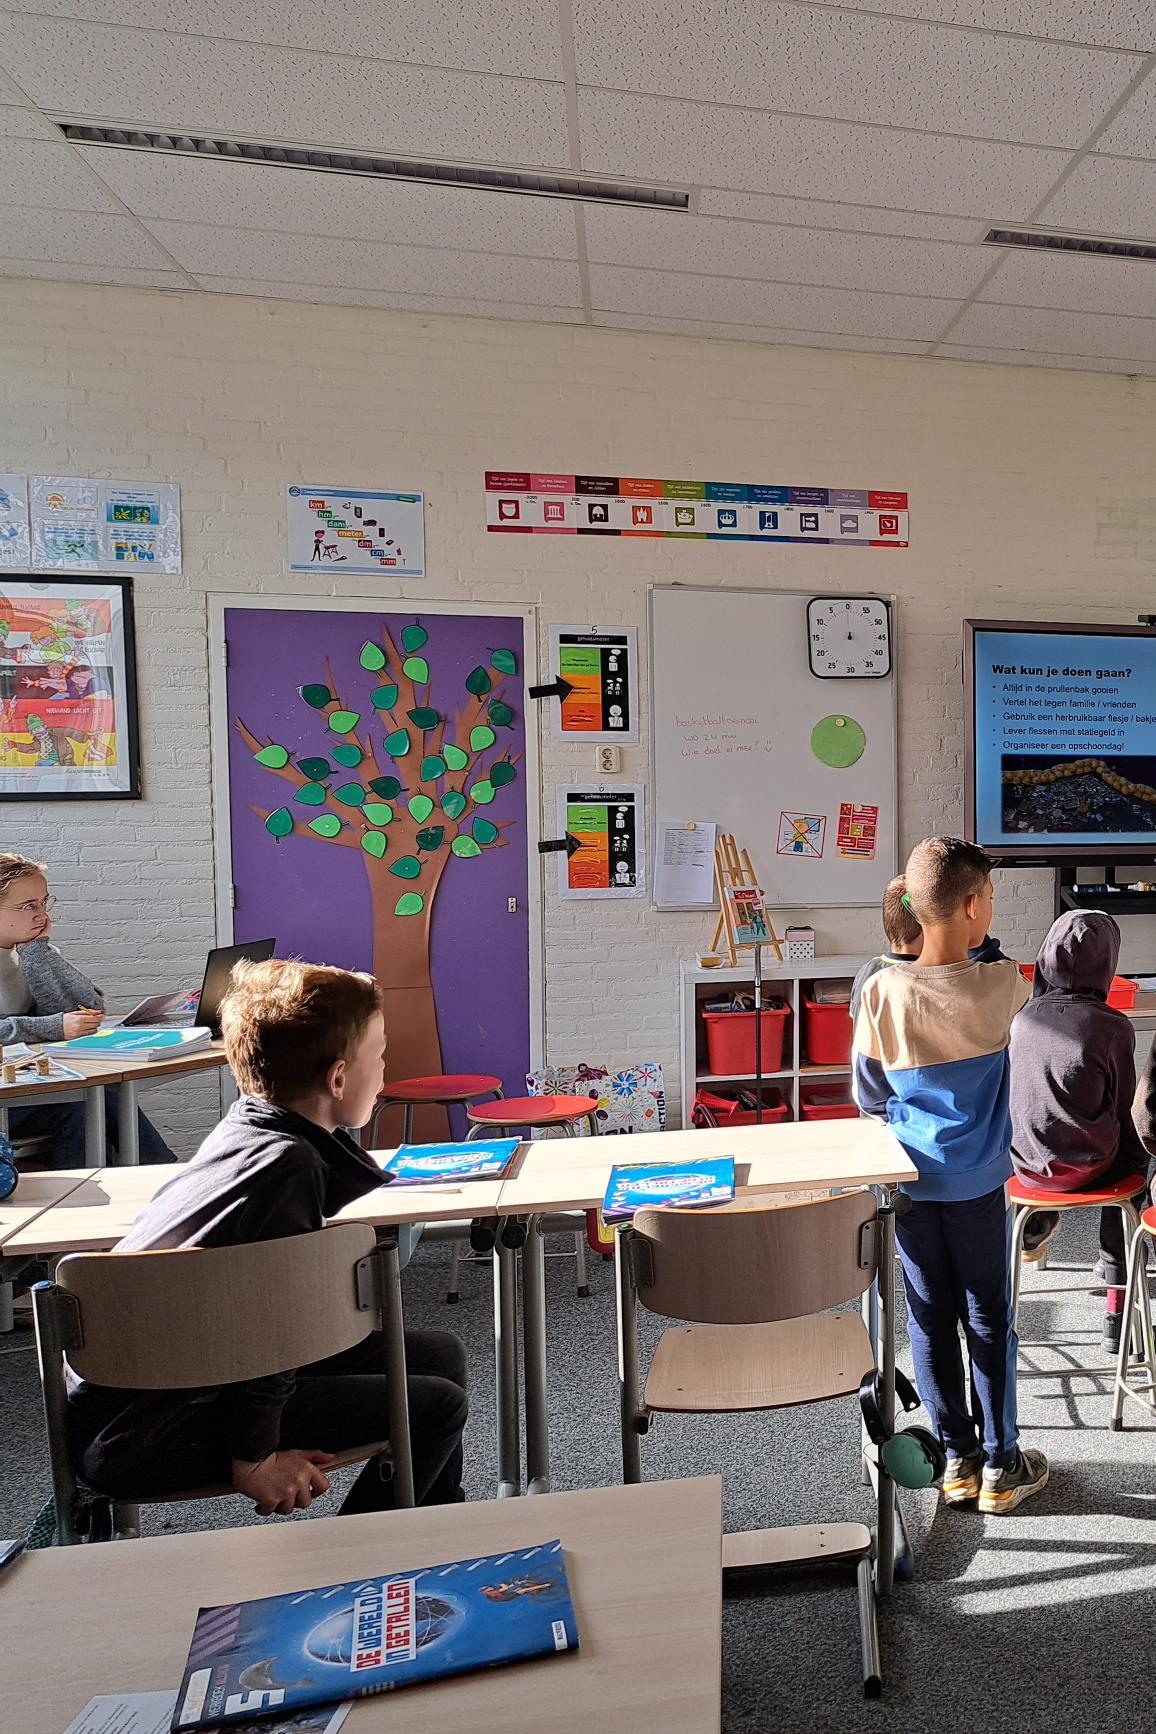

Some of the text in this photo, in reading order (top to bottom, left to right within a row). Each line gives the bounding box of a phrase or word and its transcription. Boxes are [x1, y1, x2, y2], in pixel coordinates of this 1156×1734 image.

[328, 520, 346, 528] dam
[339, 530, 362, 538] meter
[816, 618, 824, 626] 10
[591, 625, 598, 634] 5
[846, 666, 855, 674] 30
[992, 664, 1132, 679] Wat kun je doen gaan?
[1002, 683, 1119, 696] Altijd in de prullenbak gooien
[1003, 698, 1026, 706] Vertel
[1029, 698, 1043, 707] het
[1044, 700, 1067, 709] tegen
[1069, 700, 1096, 708] familie
[1102, 700, 1136, 709] vrienden
[1003, 712, 1035, 721] Gebruik
[1055, 713, 1105, 722] herbruikbaar
[1108, 714, 1129, 724] flesje
[1136, 715, 1156, 724] bakje
[1003, 727, 1027, 735] Lever
[1028, 727, 1057, 736] flessen
[1060, 728, 1075, 736] met
[1078, 728, 1116, 738] statiegeld
[704, 745, 722, 755] doet
[1003, 741, 1049, 750] Organiseer
[657, 1091, 666, 1131] ACTION
[386, 1581, 410, 1663] IN GETALLEN
[356, 1596, 382, 1669] DE WERELD
[224, 1688, 286, 1716] 5
